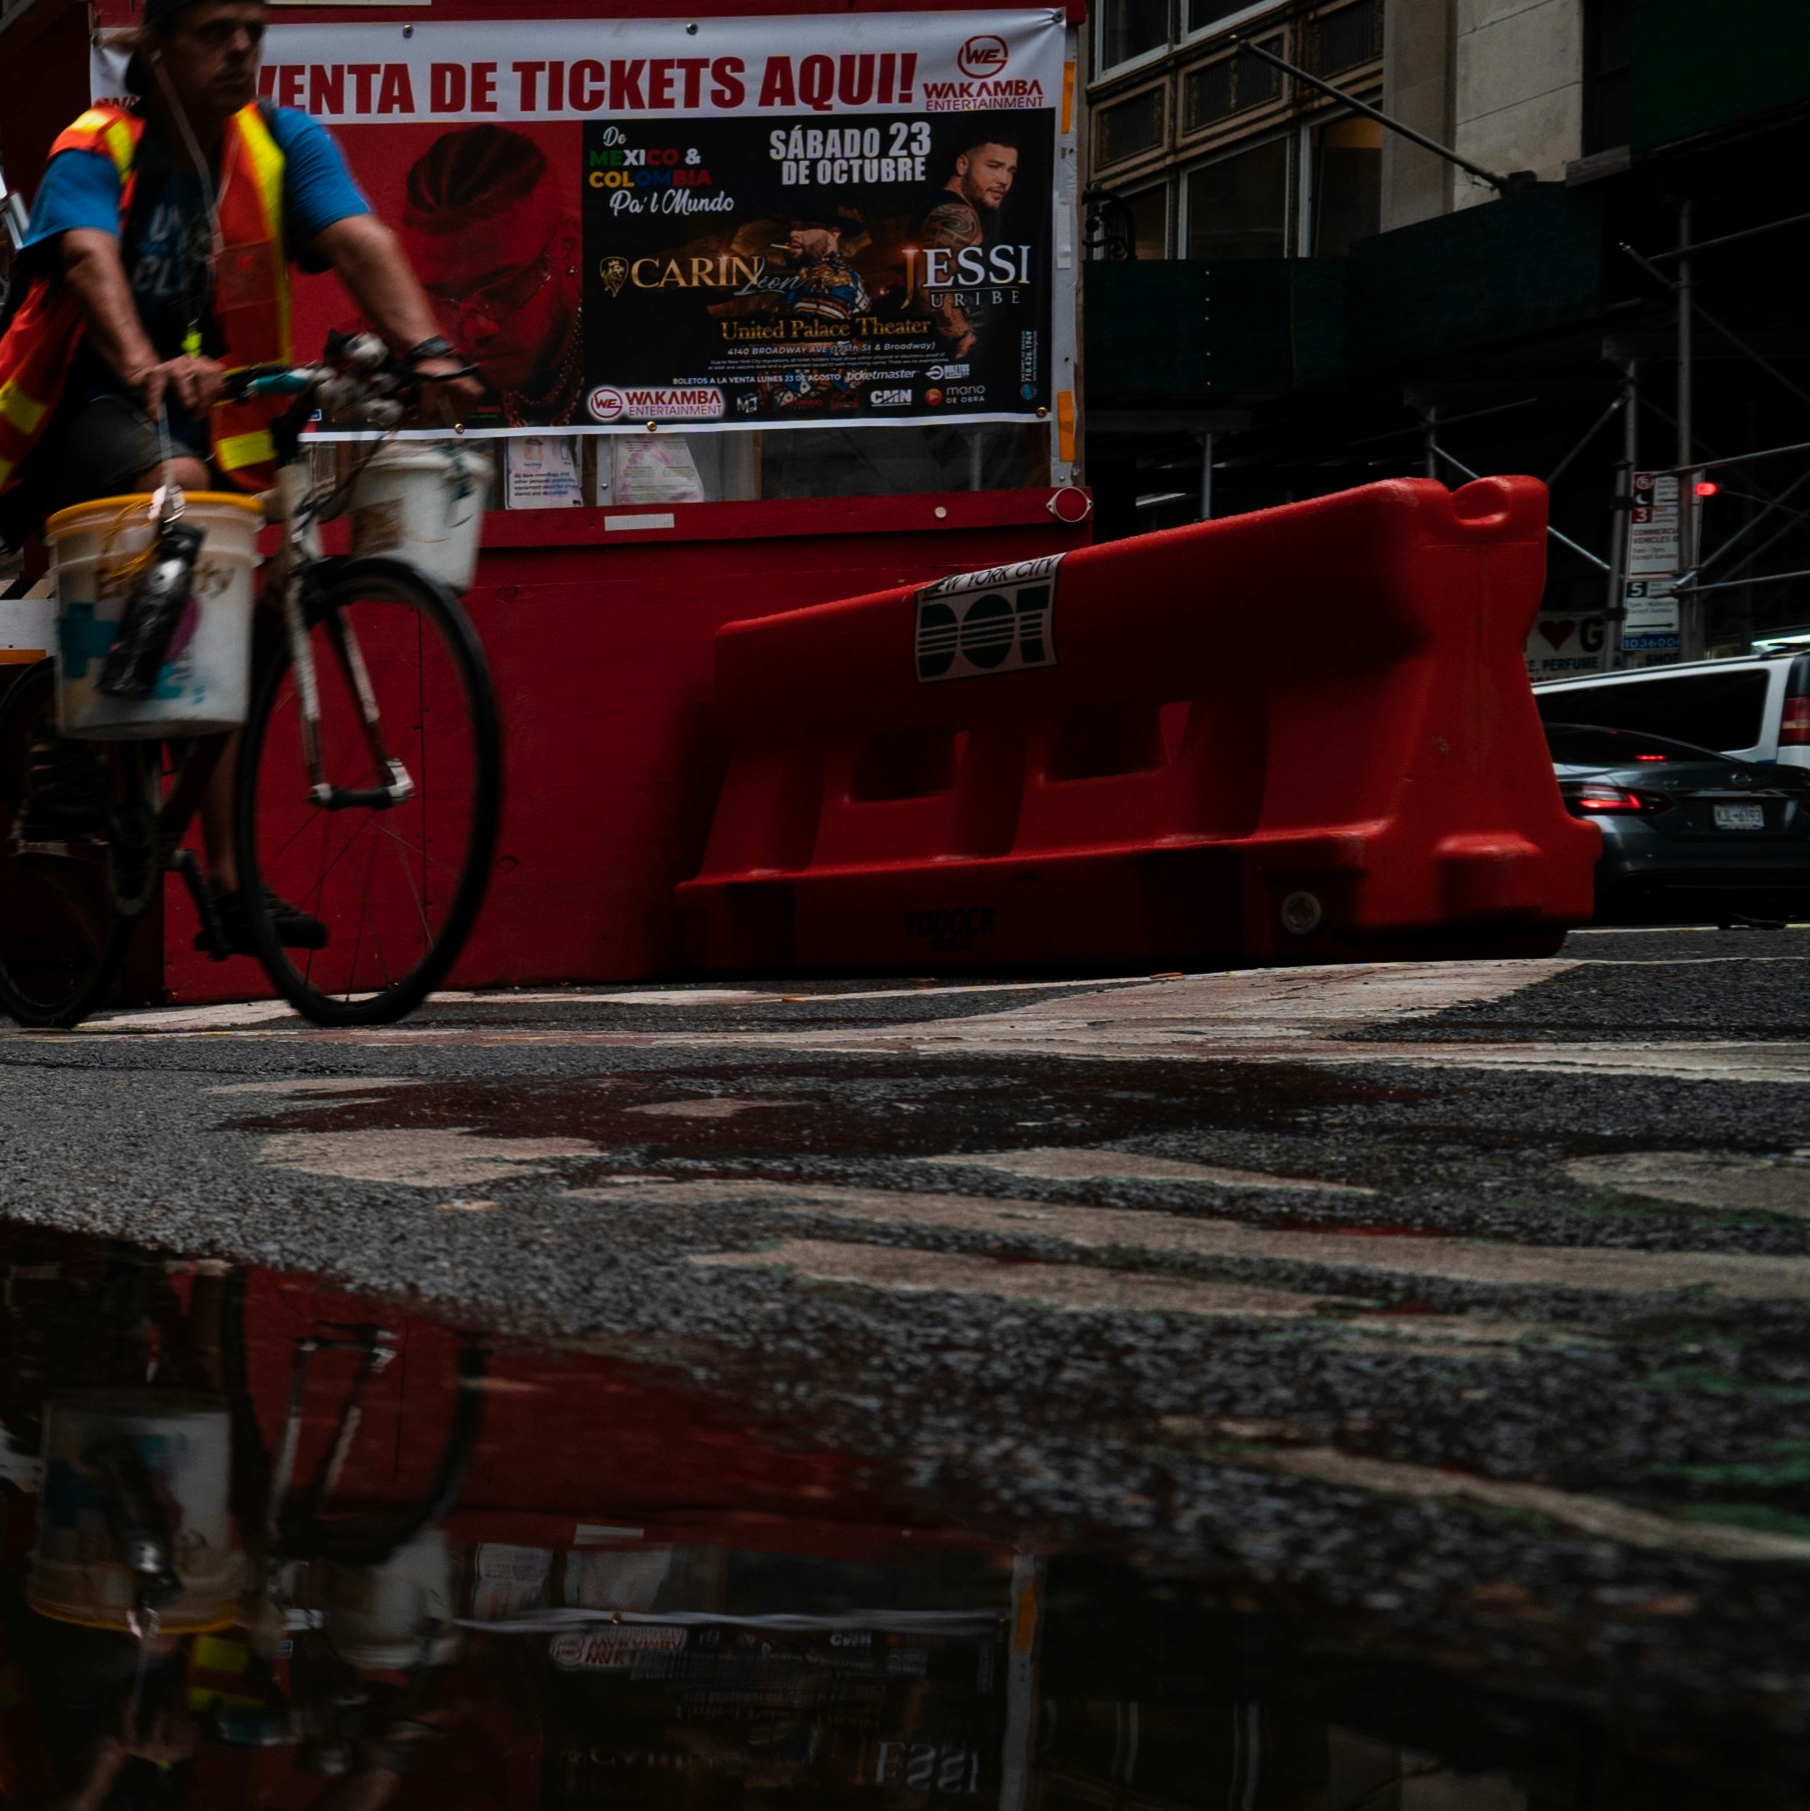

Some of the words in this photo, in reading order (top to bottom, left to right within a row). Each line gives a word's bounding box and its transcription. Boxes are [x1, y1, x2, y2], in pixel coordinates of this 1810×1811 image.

[430, 61, 498, 114] DE
[511, 54, 746, 113] TICKETS
[758, 53, 918, 111] AQUI!
[923, 79, 1043, 100] WAKAMBA
[925, 96, 1044, 112] ENTERTAINMENT
[603, 126, 627, 147] De
[769, 124, 881, 162] SÁBADO
[888, 120, 932, 158] 23
[589, 148, 680, 168] MEXICO
[685, 148, 702, 166] &
[589, 169, 713, 190] COLOMBIA
[781, 160, 810, 186] DE
[816, 156, 927, 185] OCTUBRE
[660, 189, 735, 214] Mundo
[630, 254, 761, 289] CARIN
[901, 244, 1032, 311] JESSI
[930, 291, 1022, 309] URIBE
[720, 318, 786, 342] United
[791, 317, 851, 339] Palace
[855, 315, 932, 337] Theater
[727, 346, 750, 357] 4140
[752, 345, 807, 356] BROADWAY
[809, 345, 828, 355] AVE
[884, 341, 936, 353] Broadway)
[672, 377, 708, 386] BOLETOS
[710, 376, 716, 385] A
[717, 376, 728, 385] LA
[730, 375, 756, 384] VENTA
[757, 374, 783, 384] LUNES
[785, 374, 794, 383] 23
[796, 373, 806, 383] DE
[808, 372, 841, 382] AGOSTO
[846, 368, 917, 383] ticketmaster
[625, 390, 722, 405] WAKAMBA
[870, 388, 913, 404] CMN
[946, 385, 986, 395] mano
[628, 401, 723, 417] ENTERTAINMENT
[945, 396, 958, 405] DE
[960, 395, 986, 405] OBRA
[1635, 508, 1648, 523] 3
[1633, 527, 1680, 536] COMMERCI
[966, 566, 1011, 588] YORK
[1016, 556, 1057, 578] CITY
[1543, 656, 1600, 672] PERFUME
